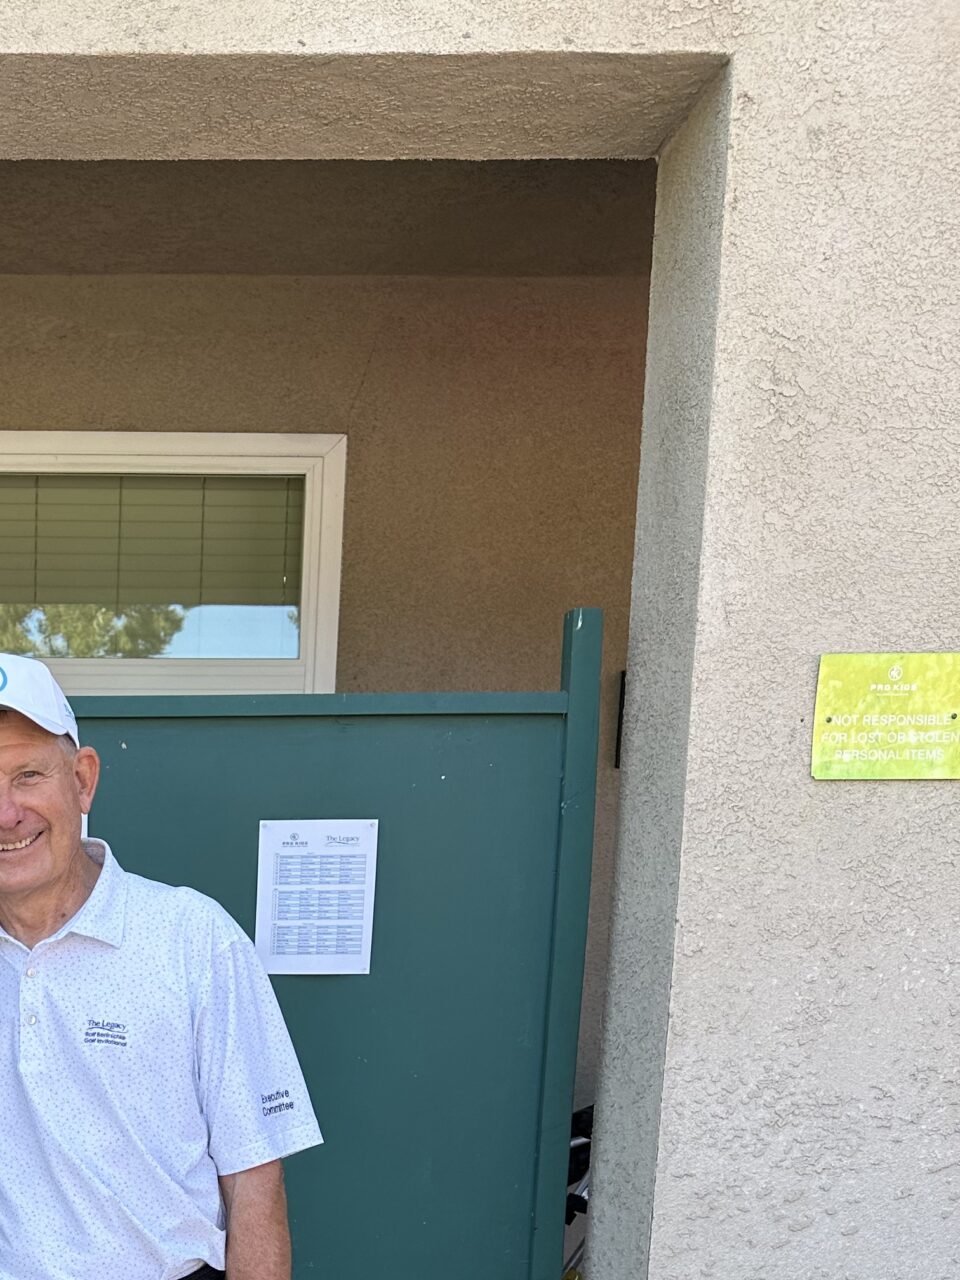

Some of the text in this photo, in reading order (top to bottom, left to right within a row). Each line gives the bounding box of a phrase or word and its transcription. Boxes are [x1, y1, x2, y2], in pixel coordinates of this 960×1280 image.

[832, 713, 952, 726] NOT RESPONSIBLE
[821, 732, 848, 743] FOR
[851, 731, 882, 744] LOST
[834, 749, 944, 761] PERSONAL ITEMS
[87, 1019, 127, 1031] The Legacy
[261, 1089, 290, 1104] Executive
[262, 1101, 294, 1117] Committee
